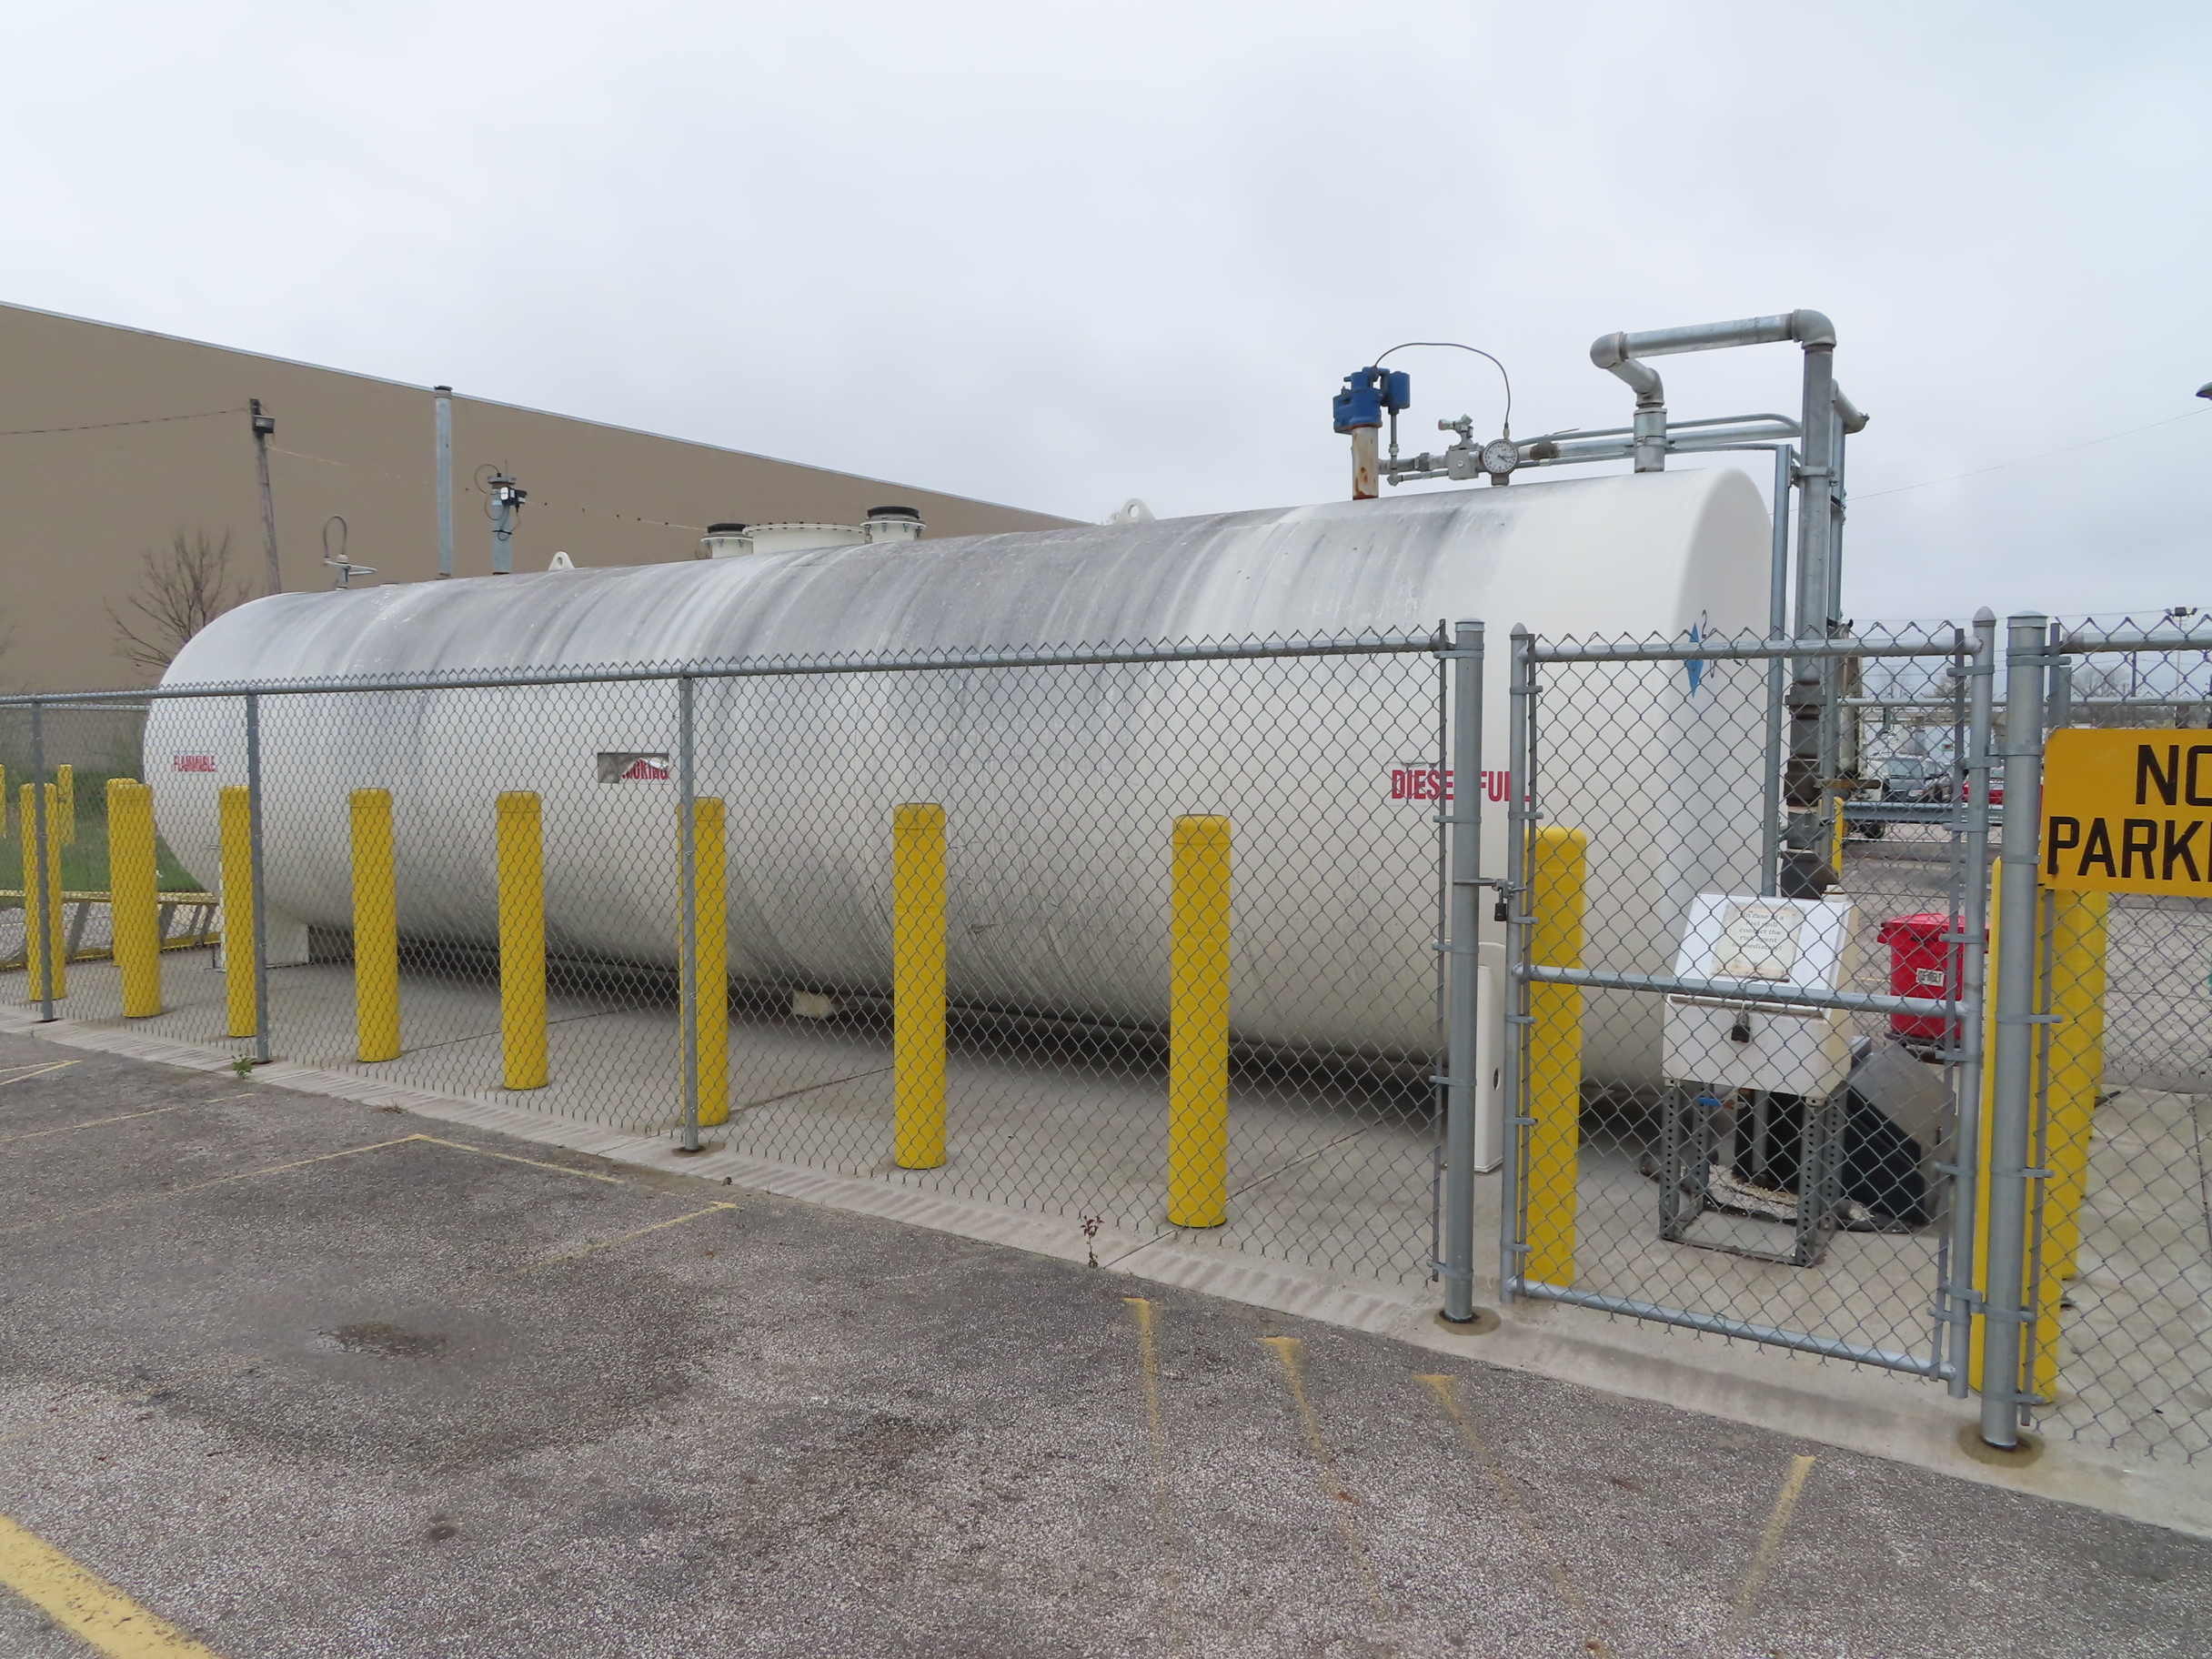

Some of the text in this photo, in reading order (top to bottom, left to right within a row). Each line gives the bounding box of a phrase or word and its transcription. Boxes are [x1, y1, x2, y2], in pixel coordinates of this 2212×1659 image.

[621, 759, 669, 780] OKING
[1391, 769, 1454, 800] DIESE
[2136, 744, 2212, 807] NO
